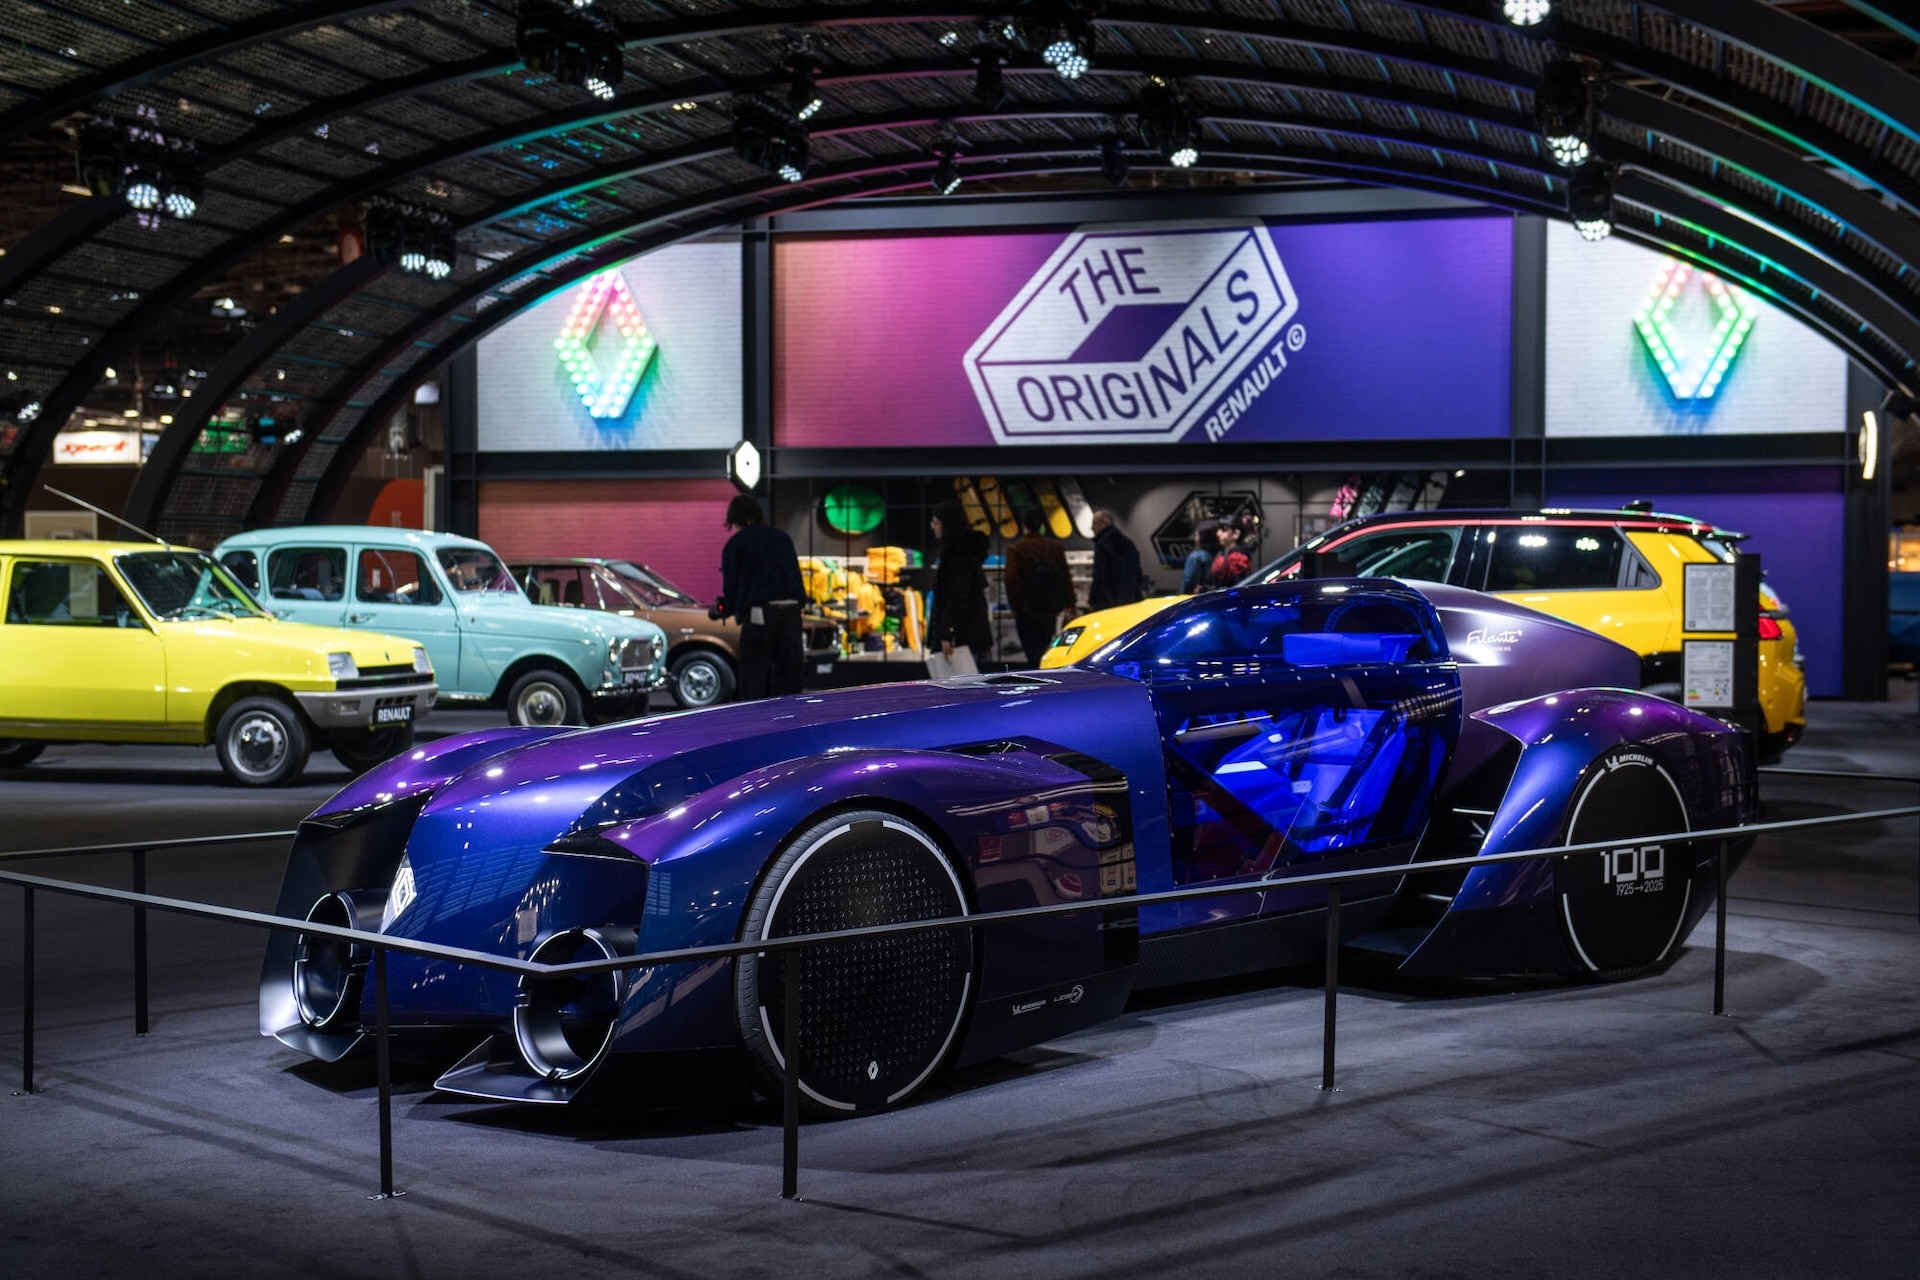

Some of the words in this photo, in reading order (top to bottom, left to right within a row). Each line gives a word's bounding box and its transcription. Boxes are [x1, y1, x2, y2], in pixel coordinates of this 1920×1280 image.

[1058, 247, 1161, 325] THE
[1016, 269, 1260, 423] ORIGINALS
[1203, 342, 1289, 443] RENAULT
[378, 706, 412, 722] RENAULT
[1618, 753, 1654, 766] MICHELIN
[1600, 844, 1665, 884] 100
[1616, 882, 1634, 896] 1925
[1644, 879, 1664, 893] 2025
